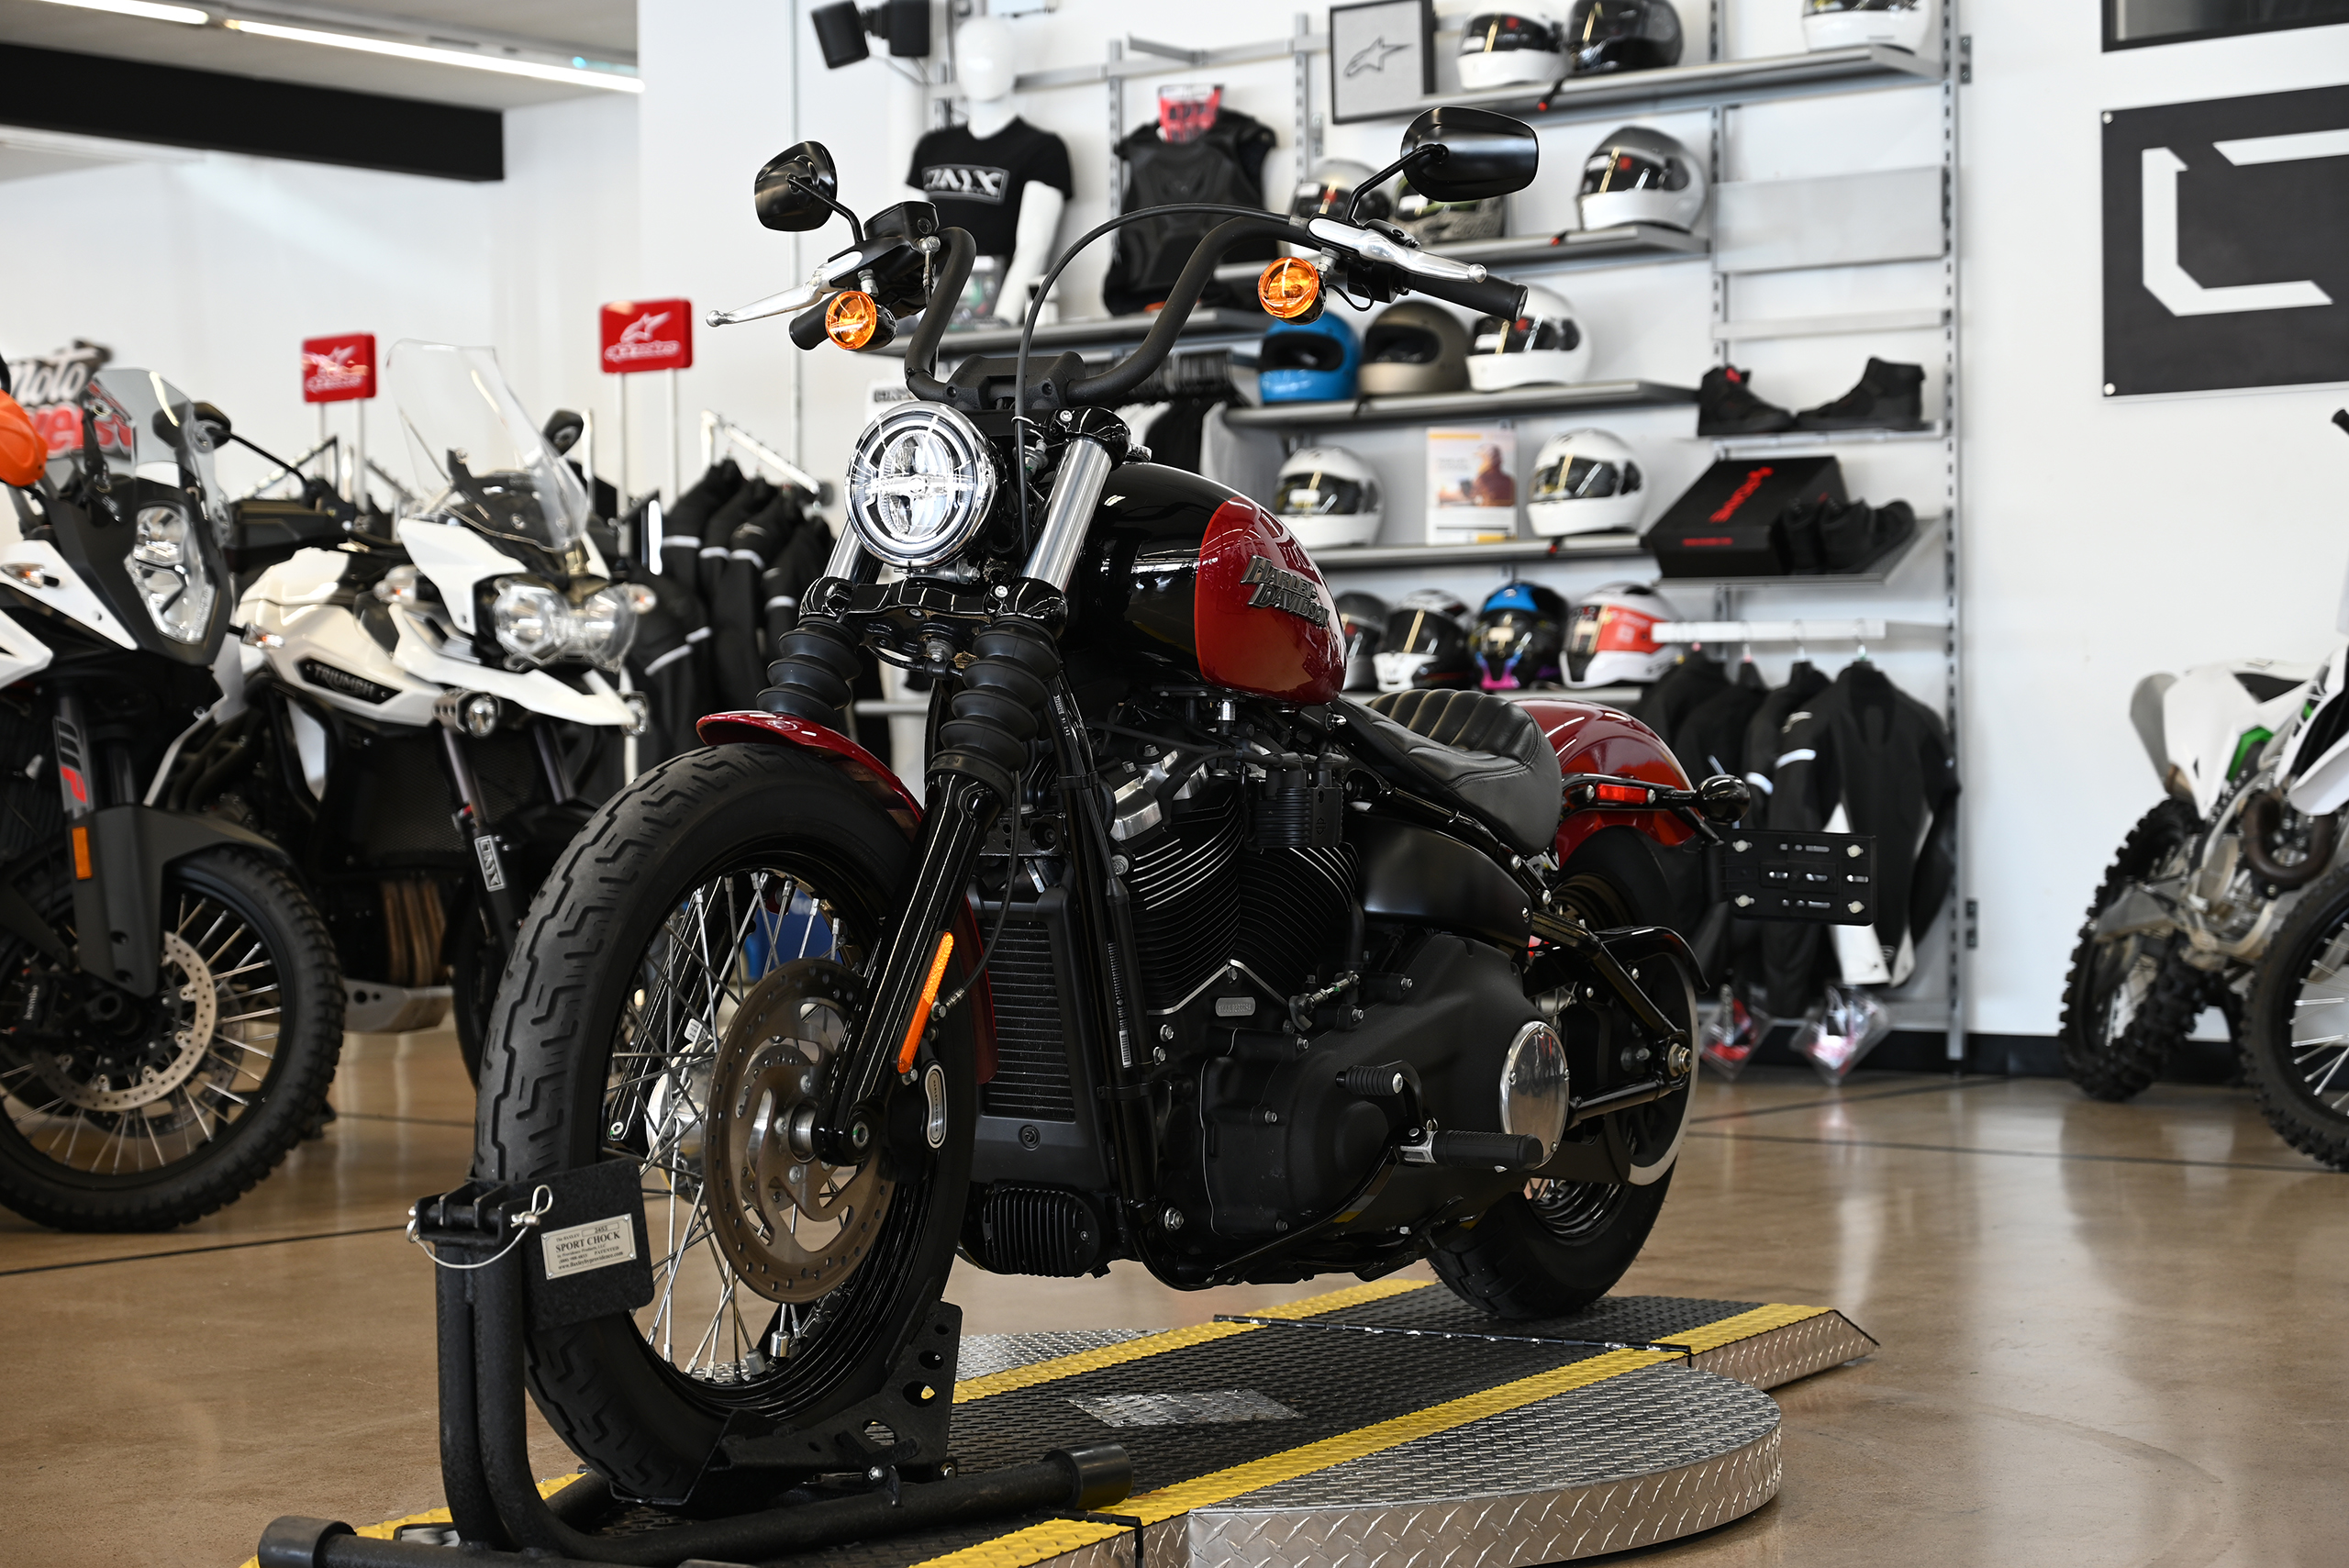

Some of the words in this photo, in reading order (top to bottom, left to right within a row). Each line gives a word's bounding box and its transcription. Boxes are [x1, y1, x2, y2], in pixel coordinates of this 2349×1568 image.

[1241, 554, 1319, 599] HARLEY-
[1248, 583, 1330, 628] DAVIDSON
[314, 663, 375, 697] TRIUMPH
[555, 1239, 585, 1253] SPORT
[587, 1230, 620, 1246] CHOCK
[594, 1246, 619, 1255] PATENTED
